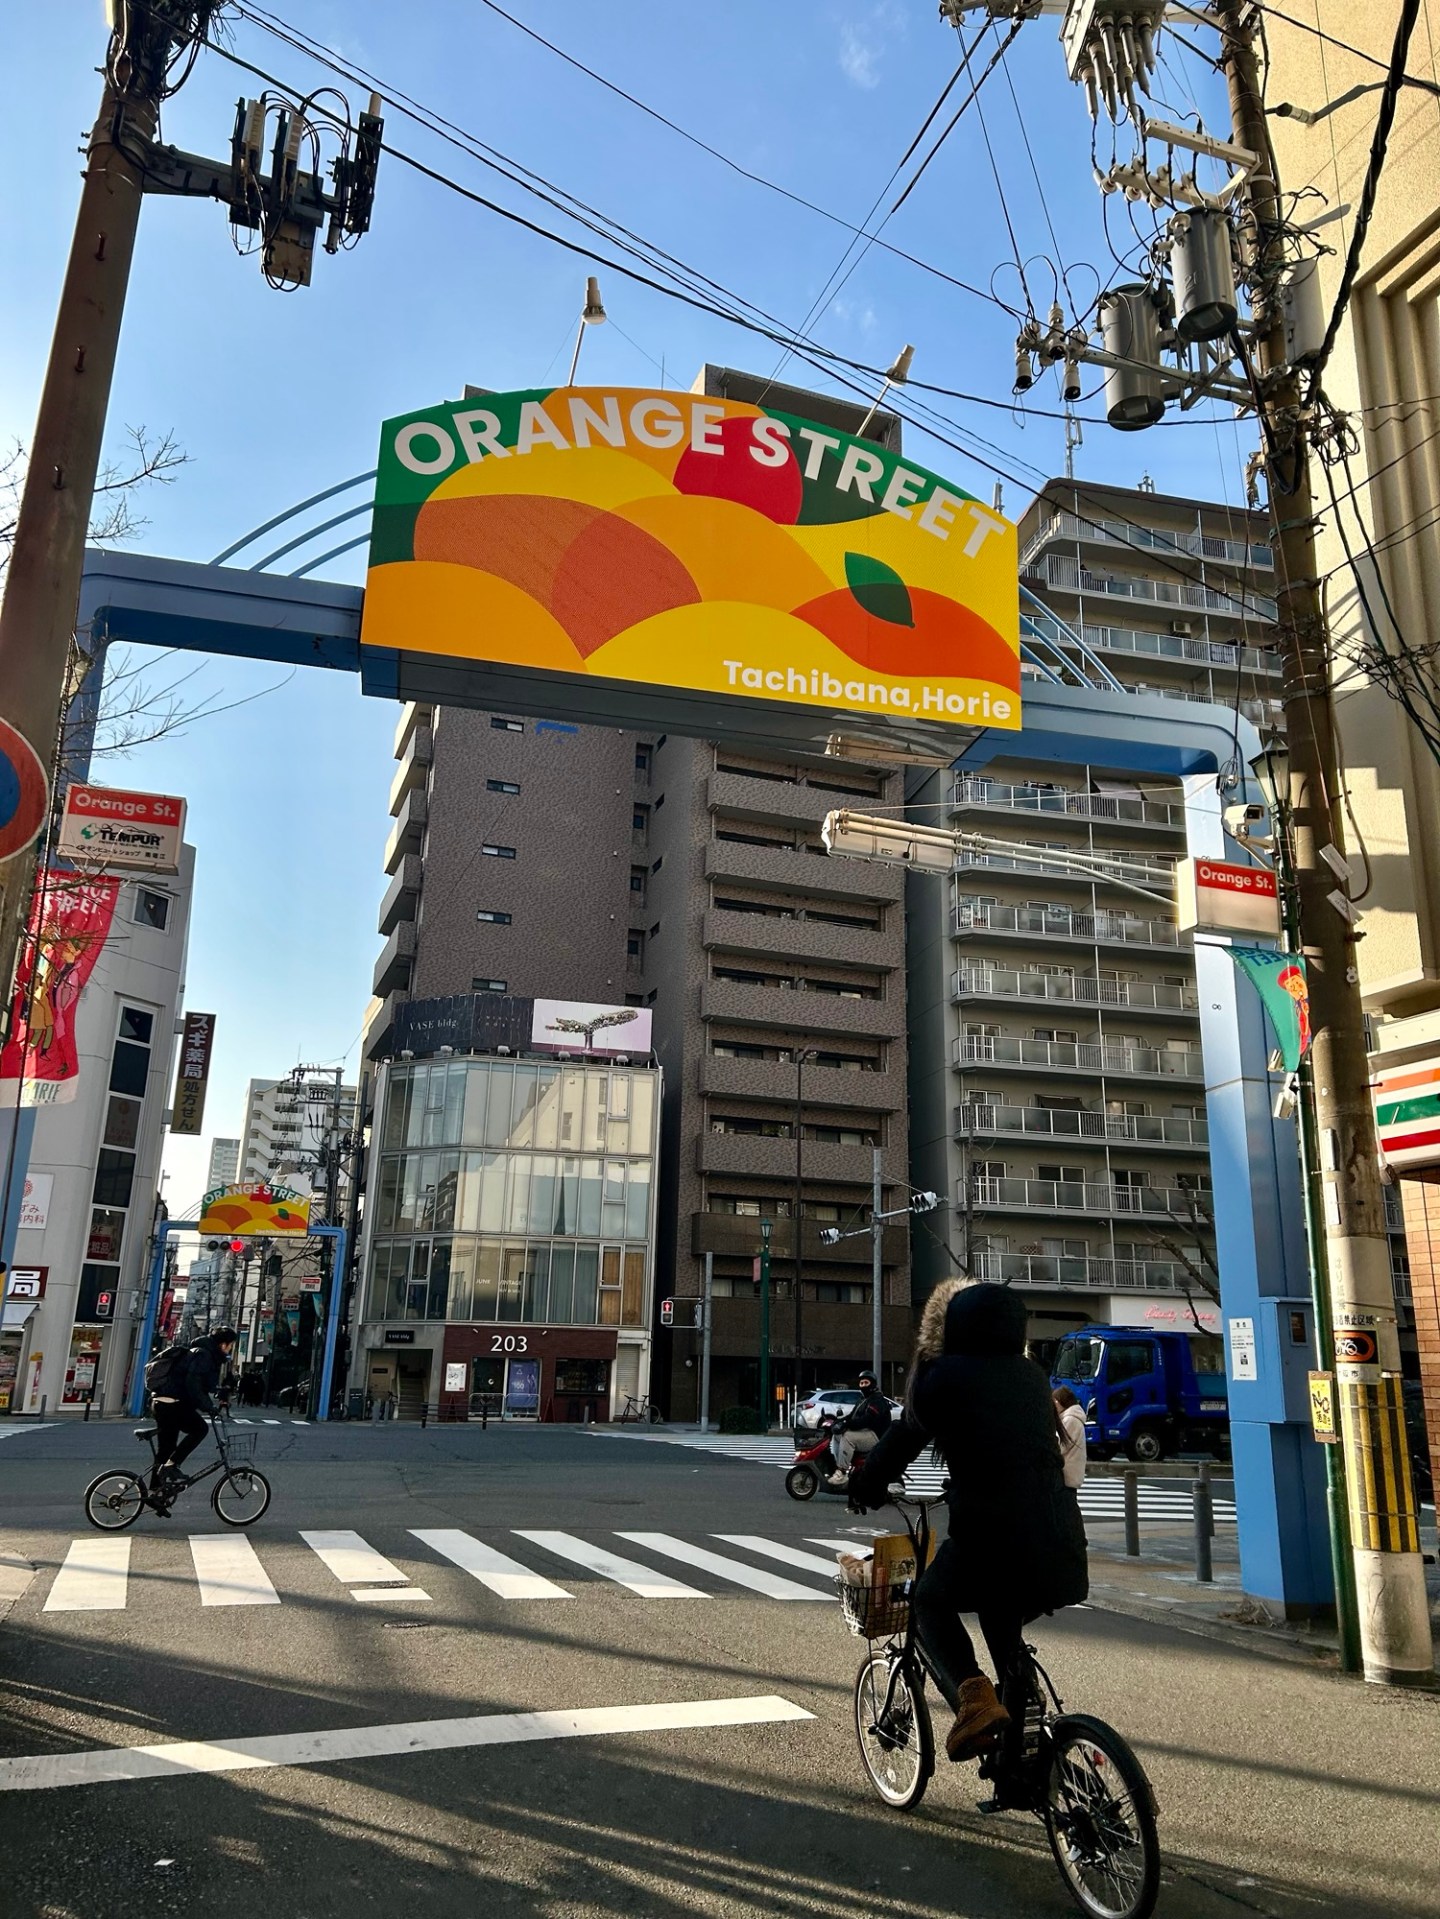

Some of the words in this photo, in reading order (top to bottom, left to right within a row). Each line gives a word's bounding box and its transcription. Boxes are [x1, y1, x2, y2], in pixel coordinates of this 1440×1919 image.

[394, 397, 725, 475] ORANGE
[749, 416, 1007, 559] STREET
[75, 793, 147, 816] Orange
[152, 802, 176, 818] St.
[100, 829, 161, 846] TEMPUR
[1200, 866, 1252, 888] Orange
[1256, 875, 1273, 890] St.
[409, 1020, 435, 1030] VASE
[183, 1015, 209, 1079] スギ薬局
[179, 1081, 200, 1131] 処方せん
[204, 1184, 260, 1204] ORANGE
[263, 1184, 308, 1207] STREET
[19, 1215, 44, 1224] 内科
[490, 1335, 528, 1352] 203
